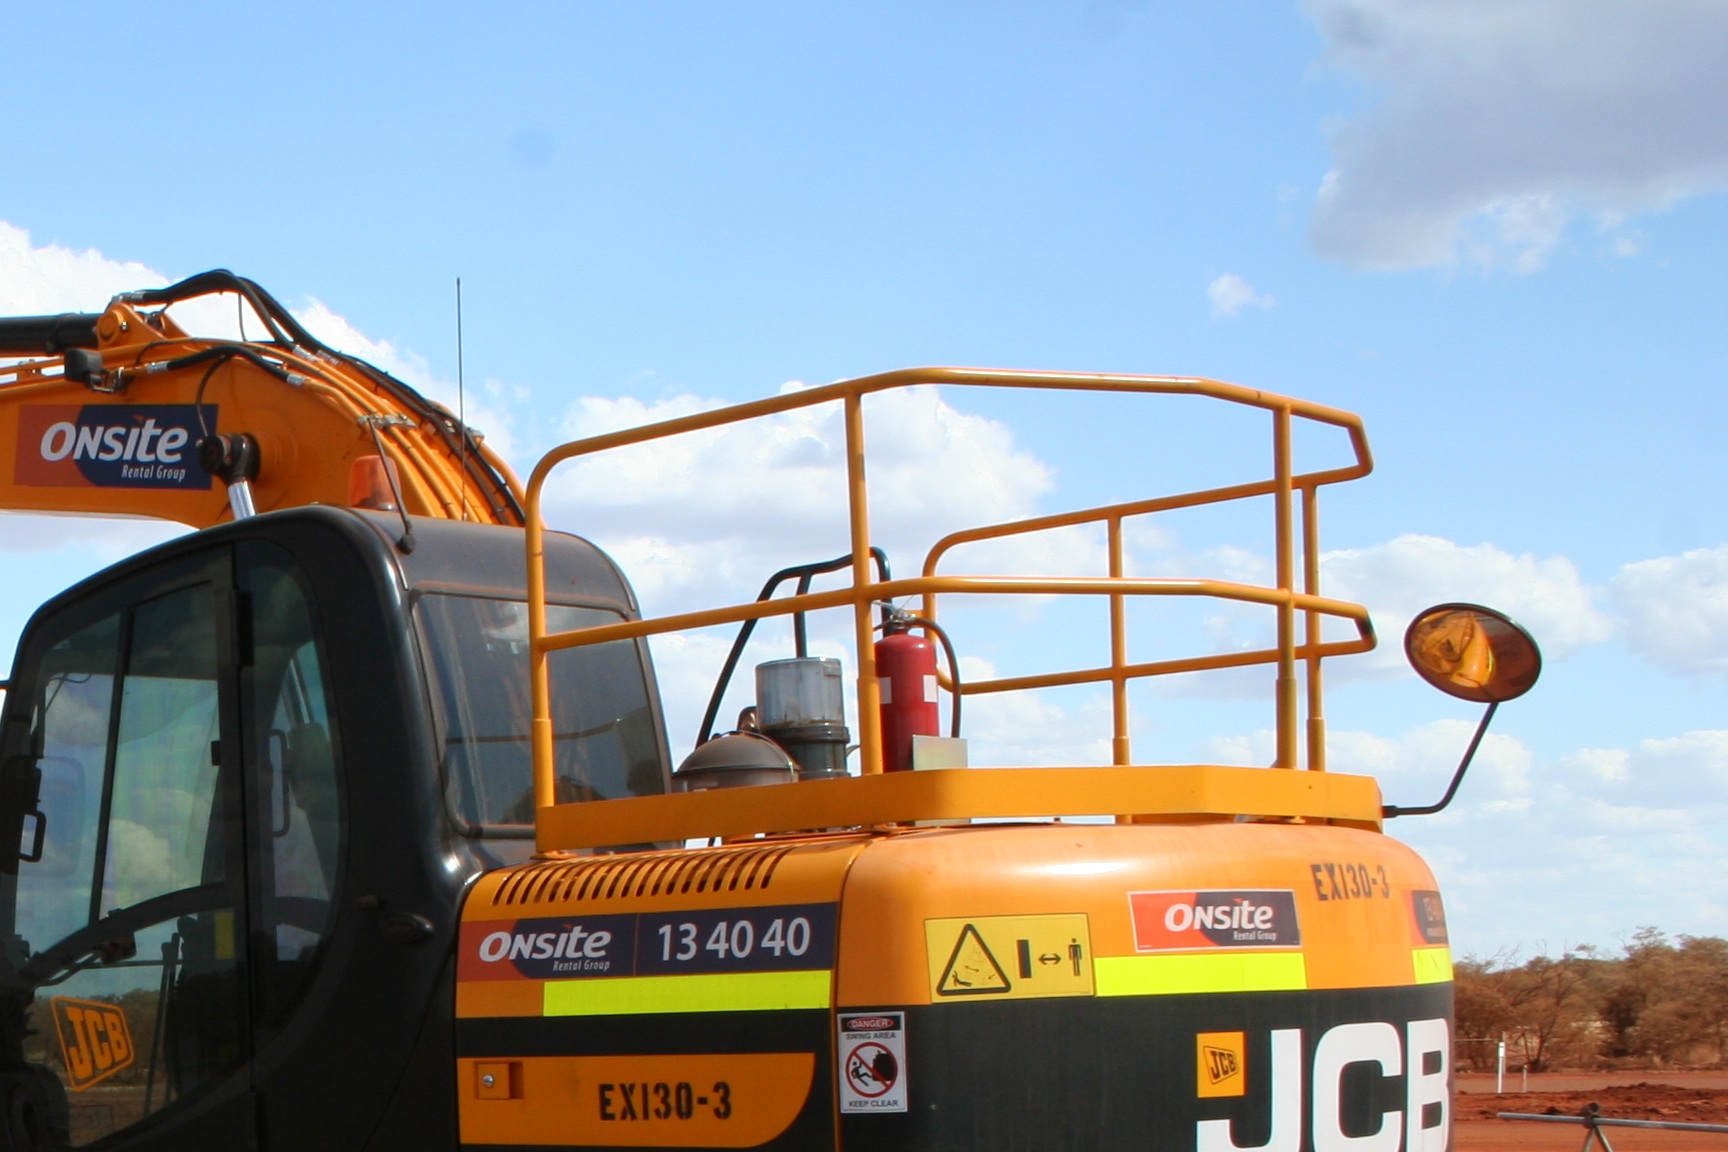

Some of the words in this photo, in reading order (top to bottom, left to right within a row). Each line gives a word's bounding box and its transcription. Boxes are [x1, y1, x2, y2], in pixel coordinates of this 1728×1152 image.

[122, 465, 154, 479] Rental
[156, 465, 186, 483] Group
[658, 922, 698, 961] 13
[705, 919, 753, 959] 40
[760, 917, 811, 957] 40
[1233, 930, 1256, 940] Rental
[1257, 930, 1277, 942] Group
[553, 960, 582, 971] Rental
[584, 960, 610, 972] Group
[850, 1018, 889, 1029] DANGER
[873, 1031, 897, 1039] AREA
[64, 1006, 128, 1080] JCB
[1209, 1050, 1236, 1080] JCB
[848, 1100, 869, 1108] KEEP
[871, 1099, 899, 1107] CLEAR
